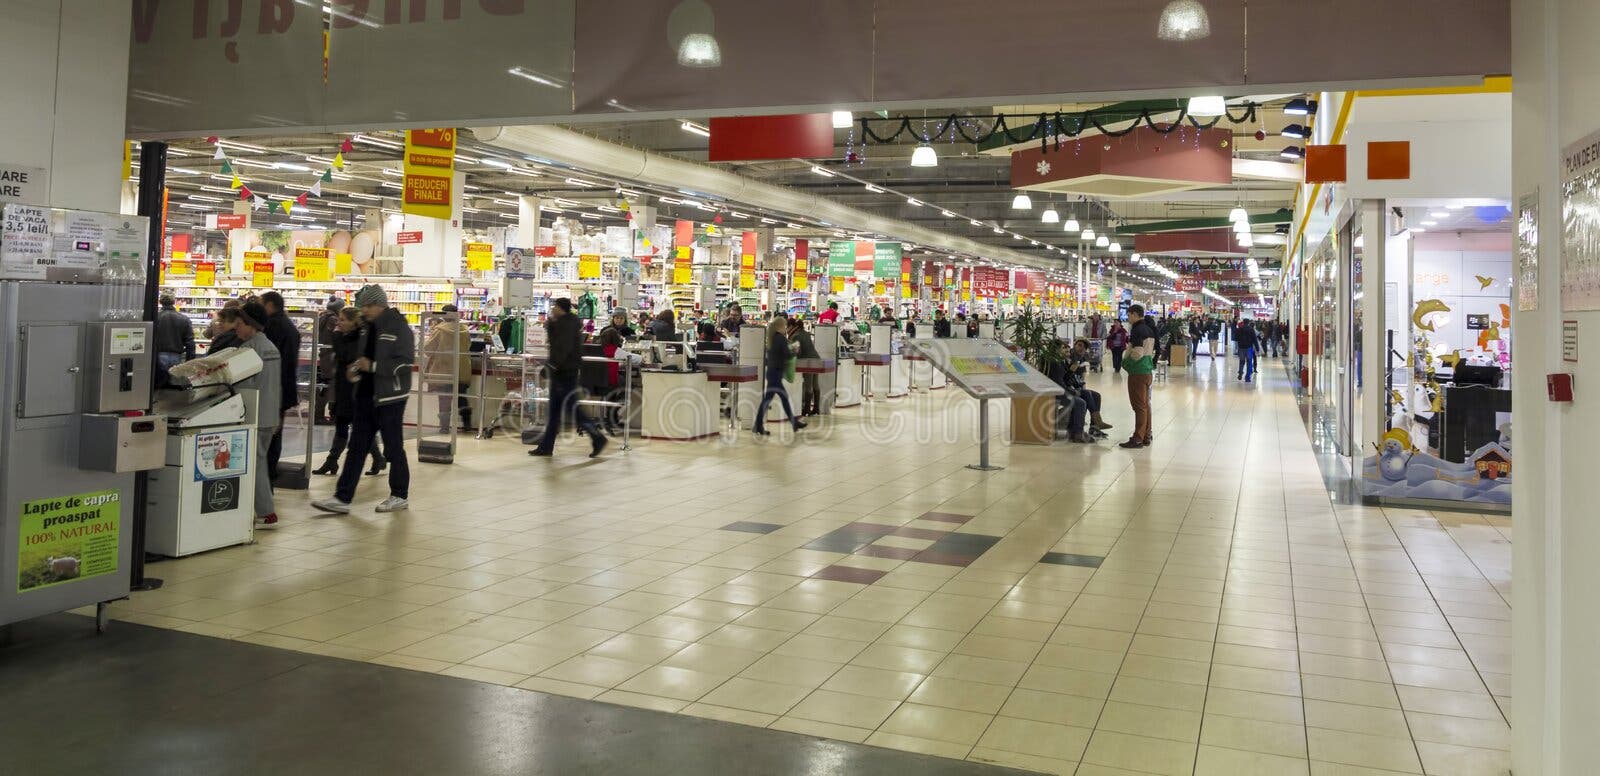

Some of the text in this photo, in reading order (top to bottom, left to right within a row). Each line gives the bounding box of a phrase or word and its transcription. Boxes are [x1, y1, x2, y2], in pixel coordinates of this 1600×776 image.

[0, 170, 28, 183] ARE
[407, 178, 448, 190] REDUCERI
[414, 190, 443, 200] FINALE
[14, 207, 43, 217] LAPTE
[23, 216, 47, 224] VACA
[6, 221, 24, 233] 3,5
[24, 492, 120, 515] Lapte de capra
[43, 508, 101, 530] proaspat
[25, 521, 116, 546] 100% NATURAL
